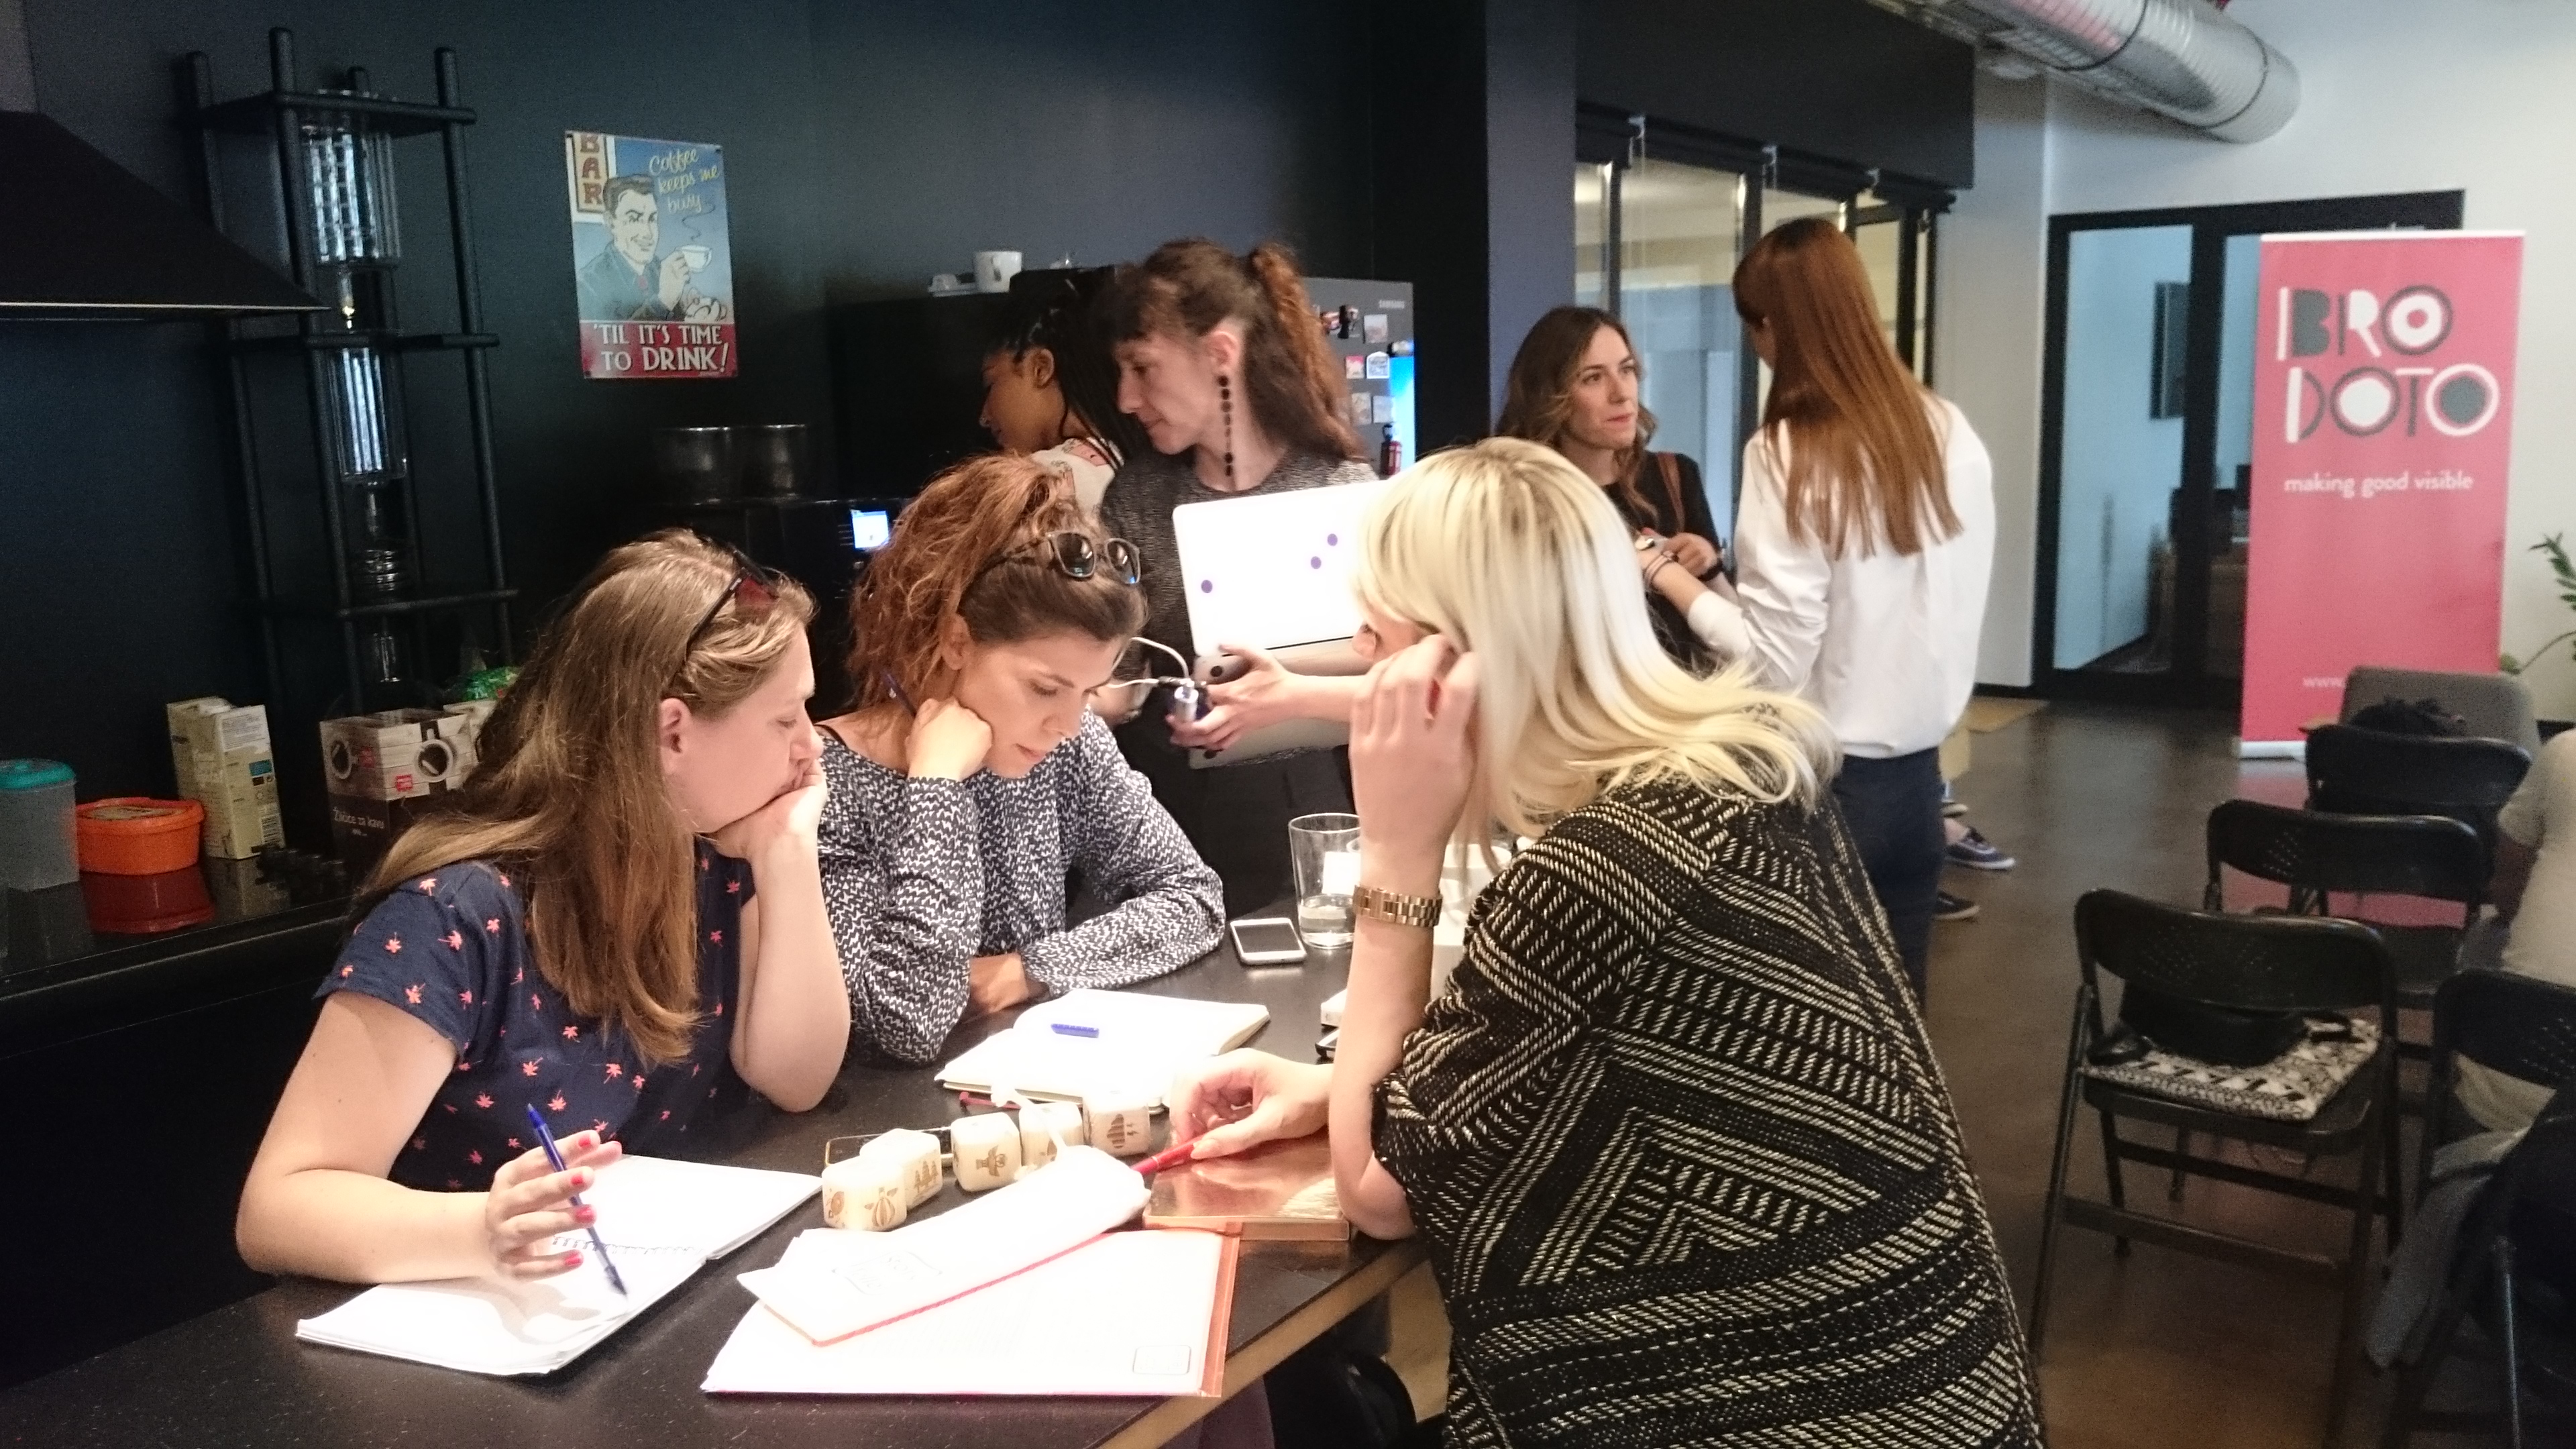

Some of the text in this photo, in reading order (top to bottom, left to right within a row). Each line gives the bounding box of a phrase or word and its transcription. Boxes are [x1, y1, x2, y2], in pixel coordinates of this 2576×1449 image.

[580, 133, 602, 204] BAR
[649, 148, 698, 176] Coffee
[658, 165, 719, 196] keeps me
[668, 195, 702, 213] busy
[594, 324, 722, 345] 'TIL IT'S TIME
[2277, 285, 2453, 361] BRO
[601, 342, 729, 373] TO DRINK!
[2286, 363, 2500, 444] DOTO
[2284, 469, 2473, 498] making good visible
